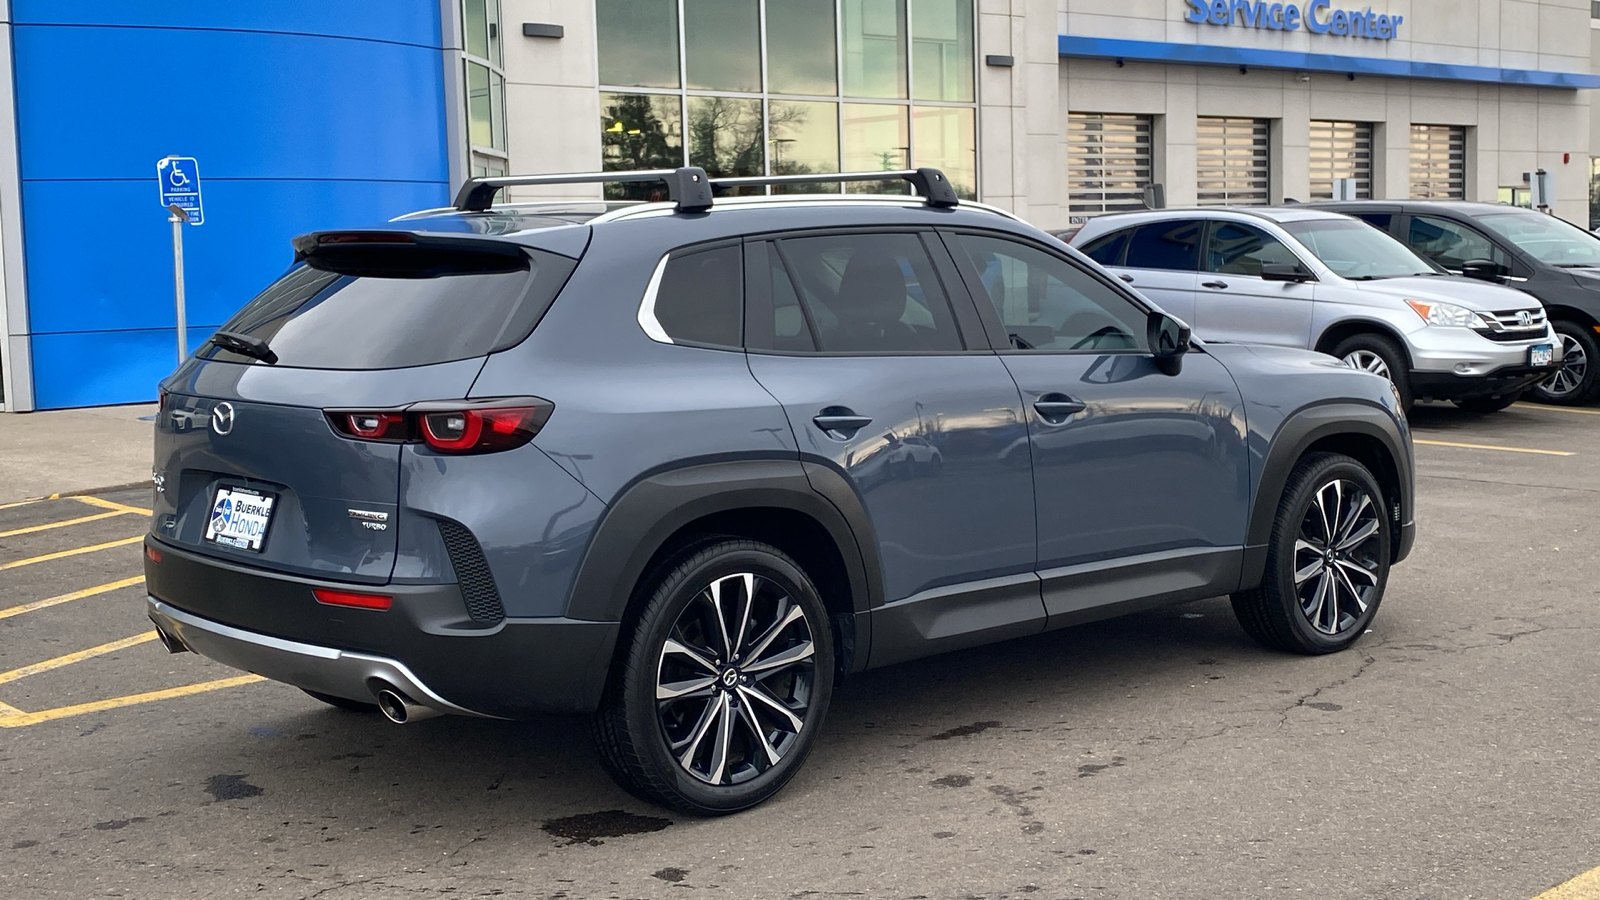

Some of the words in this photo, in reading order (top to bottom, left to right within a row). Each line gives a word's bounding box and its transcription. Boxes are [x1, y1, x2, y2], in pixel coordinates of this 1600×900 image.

[1185, 0, 1300, 31] Service
[1304, 0, 1403, 39] Center
[235, 500, 271, 518] BUERKLE
[229, 512, 265, 537] HONDA
[362, 521, 387, 531] TURBO
